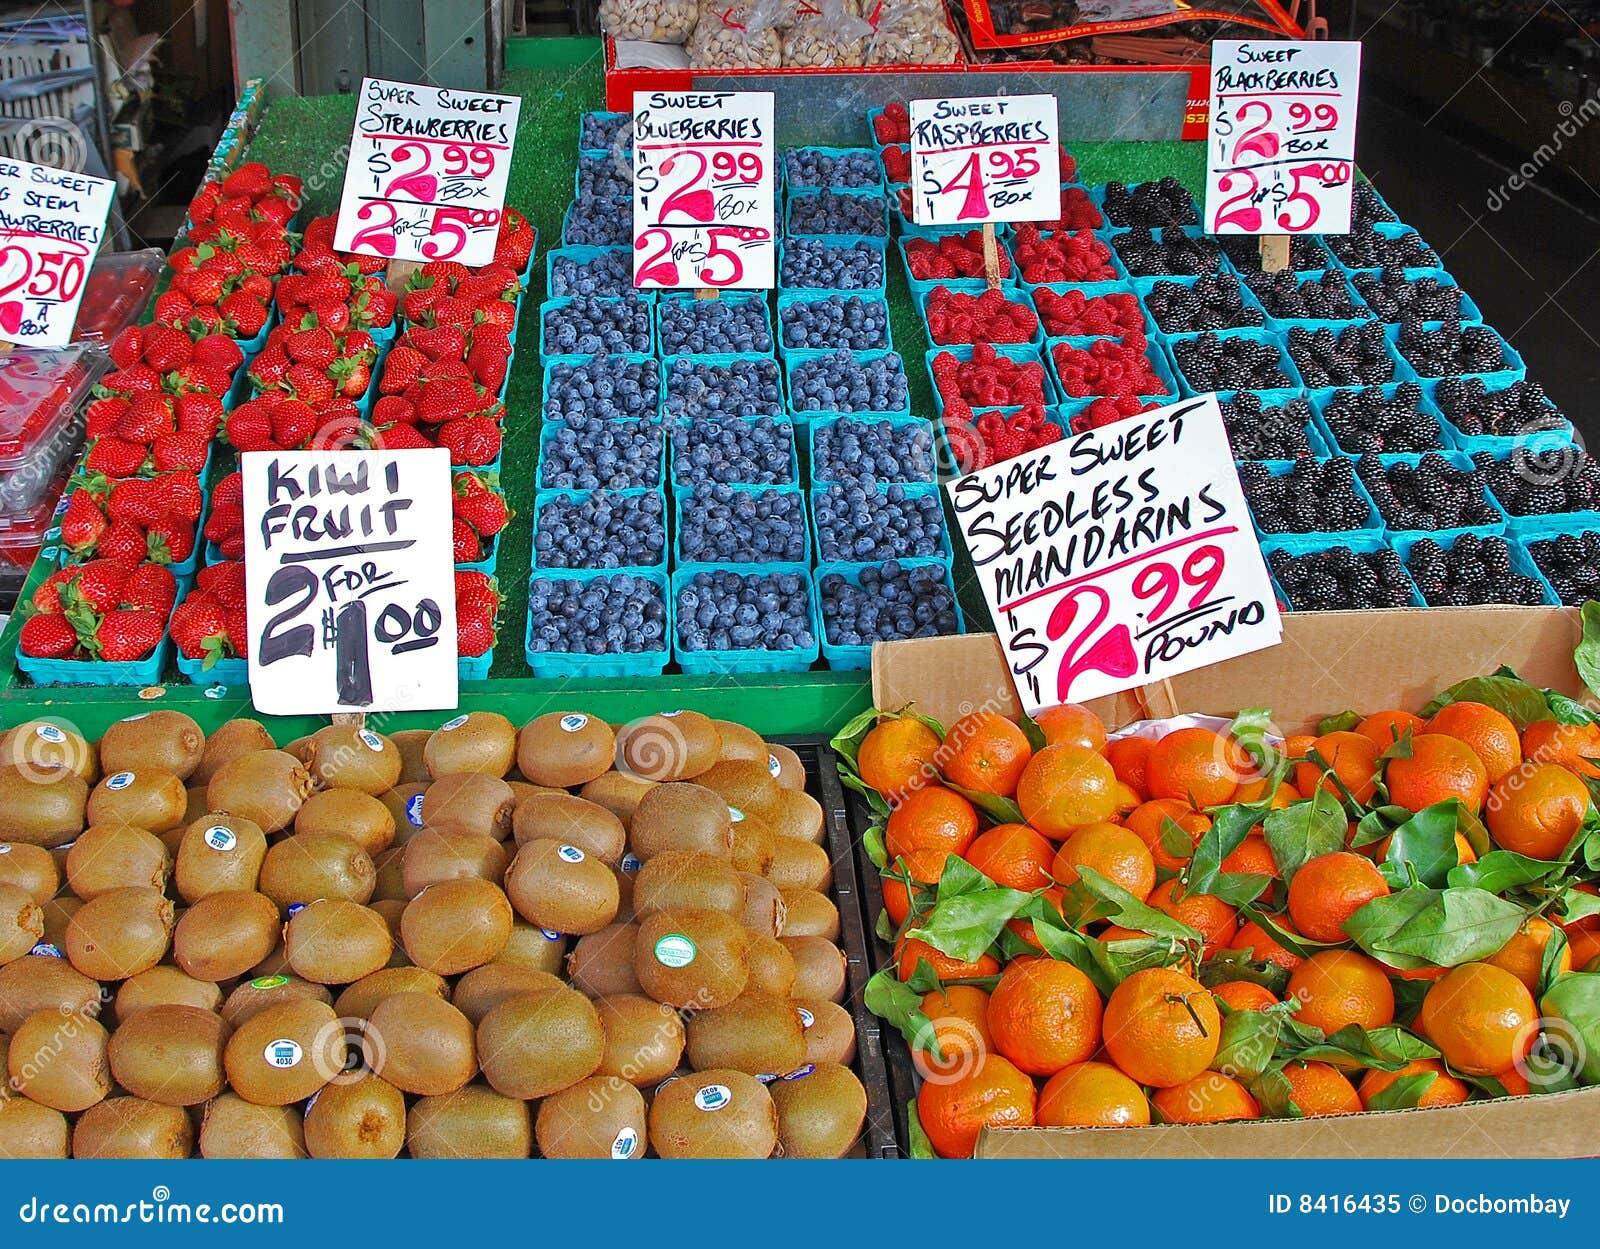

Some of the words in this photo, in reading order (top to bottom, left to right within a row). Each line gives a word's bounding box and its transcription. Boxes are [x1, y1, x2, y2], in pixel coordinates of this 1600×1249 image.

[1020, 26, 1091, 43] SUPERIOR
[1096, 21, 1149, 31] FLAVOR
[1236, 44, 1302, 64] SWEET
[1215, 65, 1338, 92] BLACKBERRIES
[367, 80, 420, 106] SUPER
[437, 89, 512, 113] SWEET
[649, 93, 735, 109] SWEET
[933, 101, 1009, 119] SWEET
[359, 103, 508, 144] STRAWBERRIES
[635, 110, 762, 141] BLUEBERRIES
[911, 120, 1049, 150] RASPBERRIES
[1282, 138, 1329, 153] BOX
[31, 167, 104, 196] SWEET
[437, 182, 490, 202] BOX
[24, 191, 80, 213] STEM
[714, 194, 758, 220] BOX
[988, 190, 1033, 208] BOX
[1214, 168, 1262, 234] 2
[351, 200, 397, 257] 2
[635, 228, 679, 287] 2
[20, 319, 49, 335] BOX
[37, 303, 56, 322] A
[954, 454, 1058, 513] SUPER
[1069, 400, 1207, 476] SWEET
[267, 458, 399, 506] KIWI
[261, 499, 413, 550] FRUIT
[967, 467, 1160, 566] SEEDLESS
[995, 483, 1227, 605] MANDARINS
[258, 565, 319, 667] 2
[322, 561, 393, 602] FOR
[1145, 600, 1265, 674] POUND
